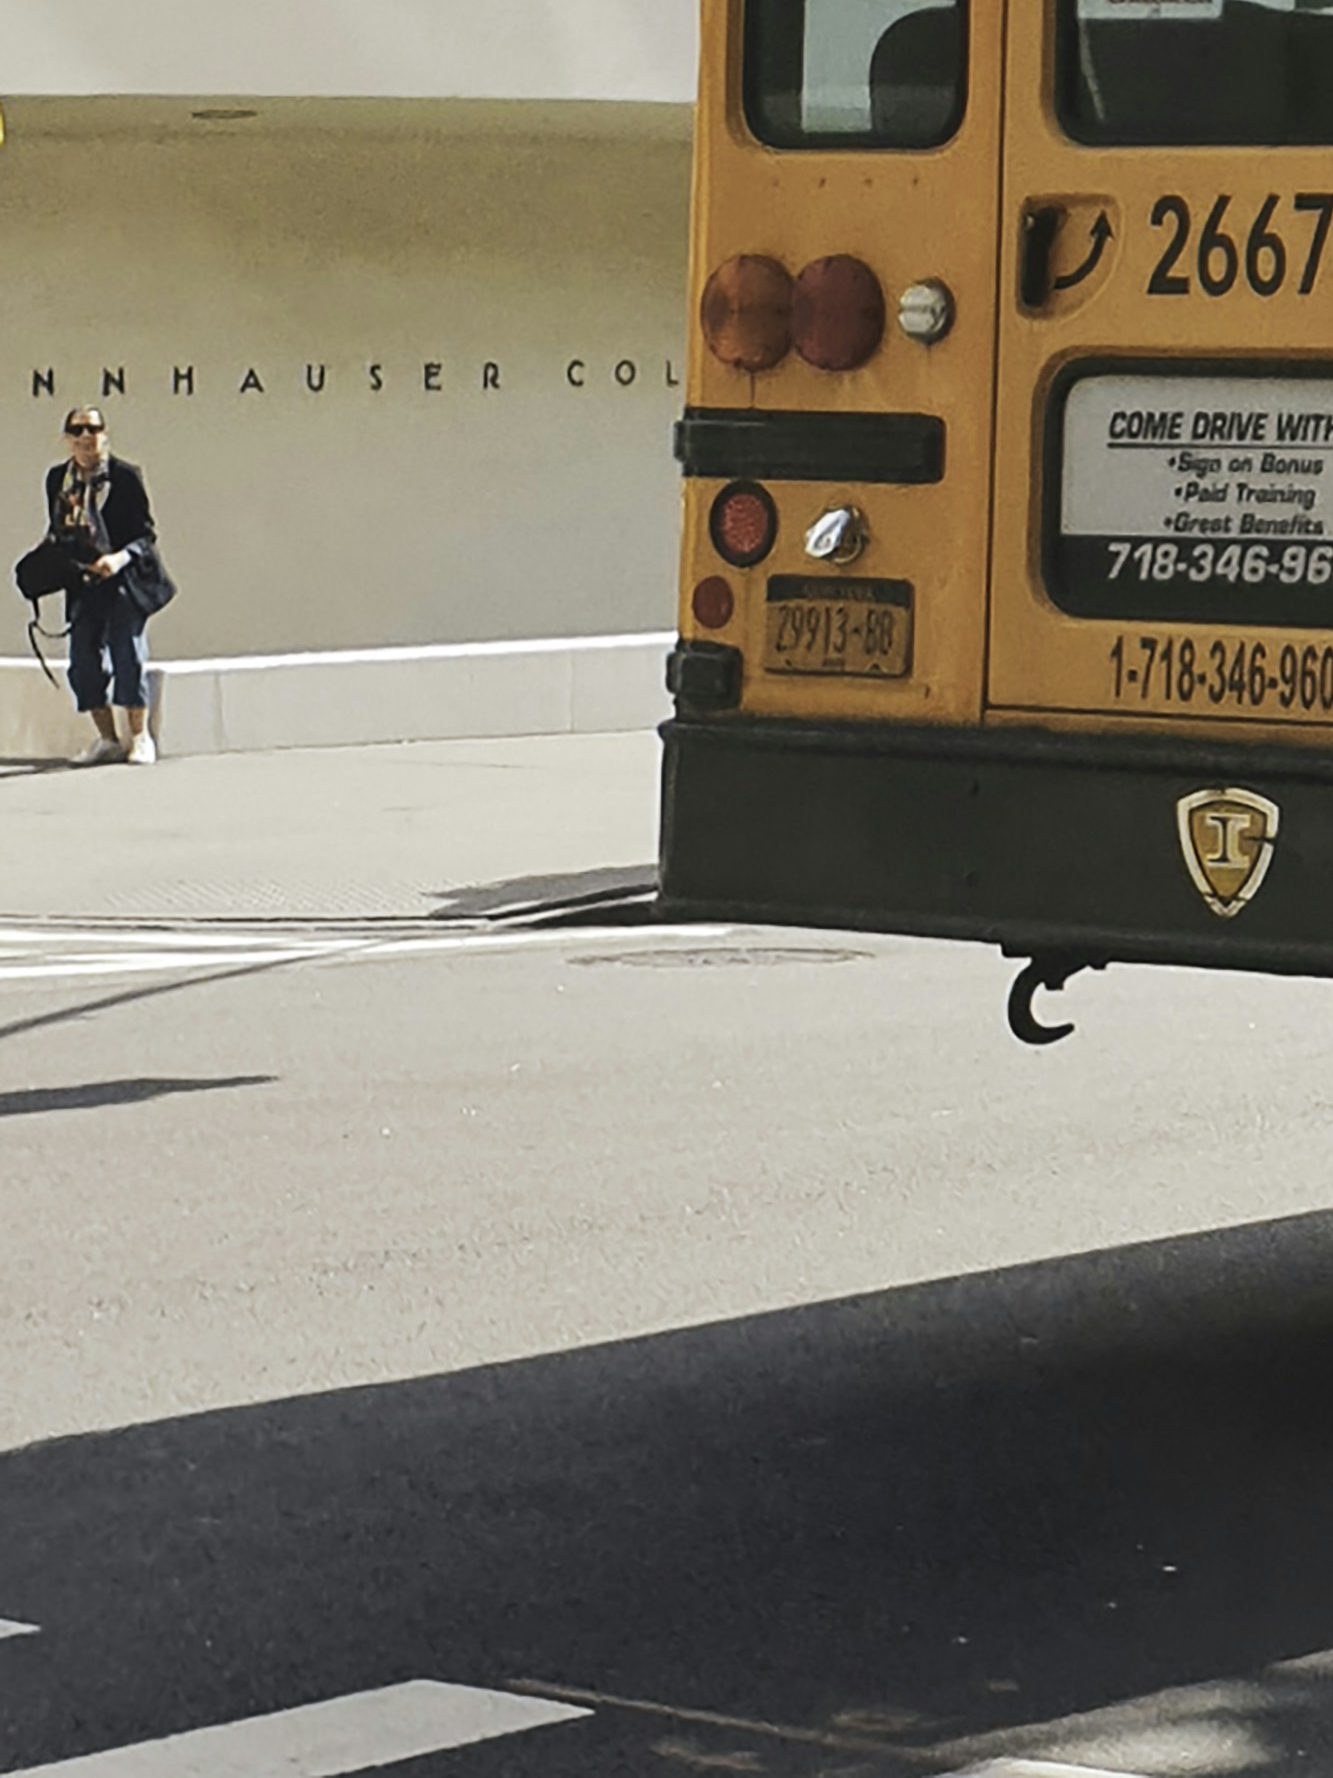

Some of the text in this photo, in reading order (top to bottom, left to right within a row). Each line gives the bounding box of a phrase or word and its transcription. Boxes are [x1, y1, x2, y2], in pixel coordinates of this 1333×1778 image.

[32, 359, 680, 398] NNHAUSER COL
[1109, 411, 1184, 441] COME
[1191, 412, 1268, 441] DRIVE
[1228, 458, 1253, 473] on
[1260, 453, 1323, 475] Bonus
[1183, 482, 1316, 509] Paid Training
[1173, 512, 1323, 535] Great Benefits
